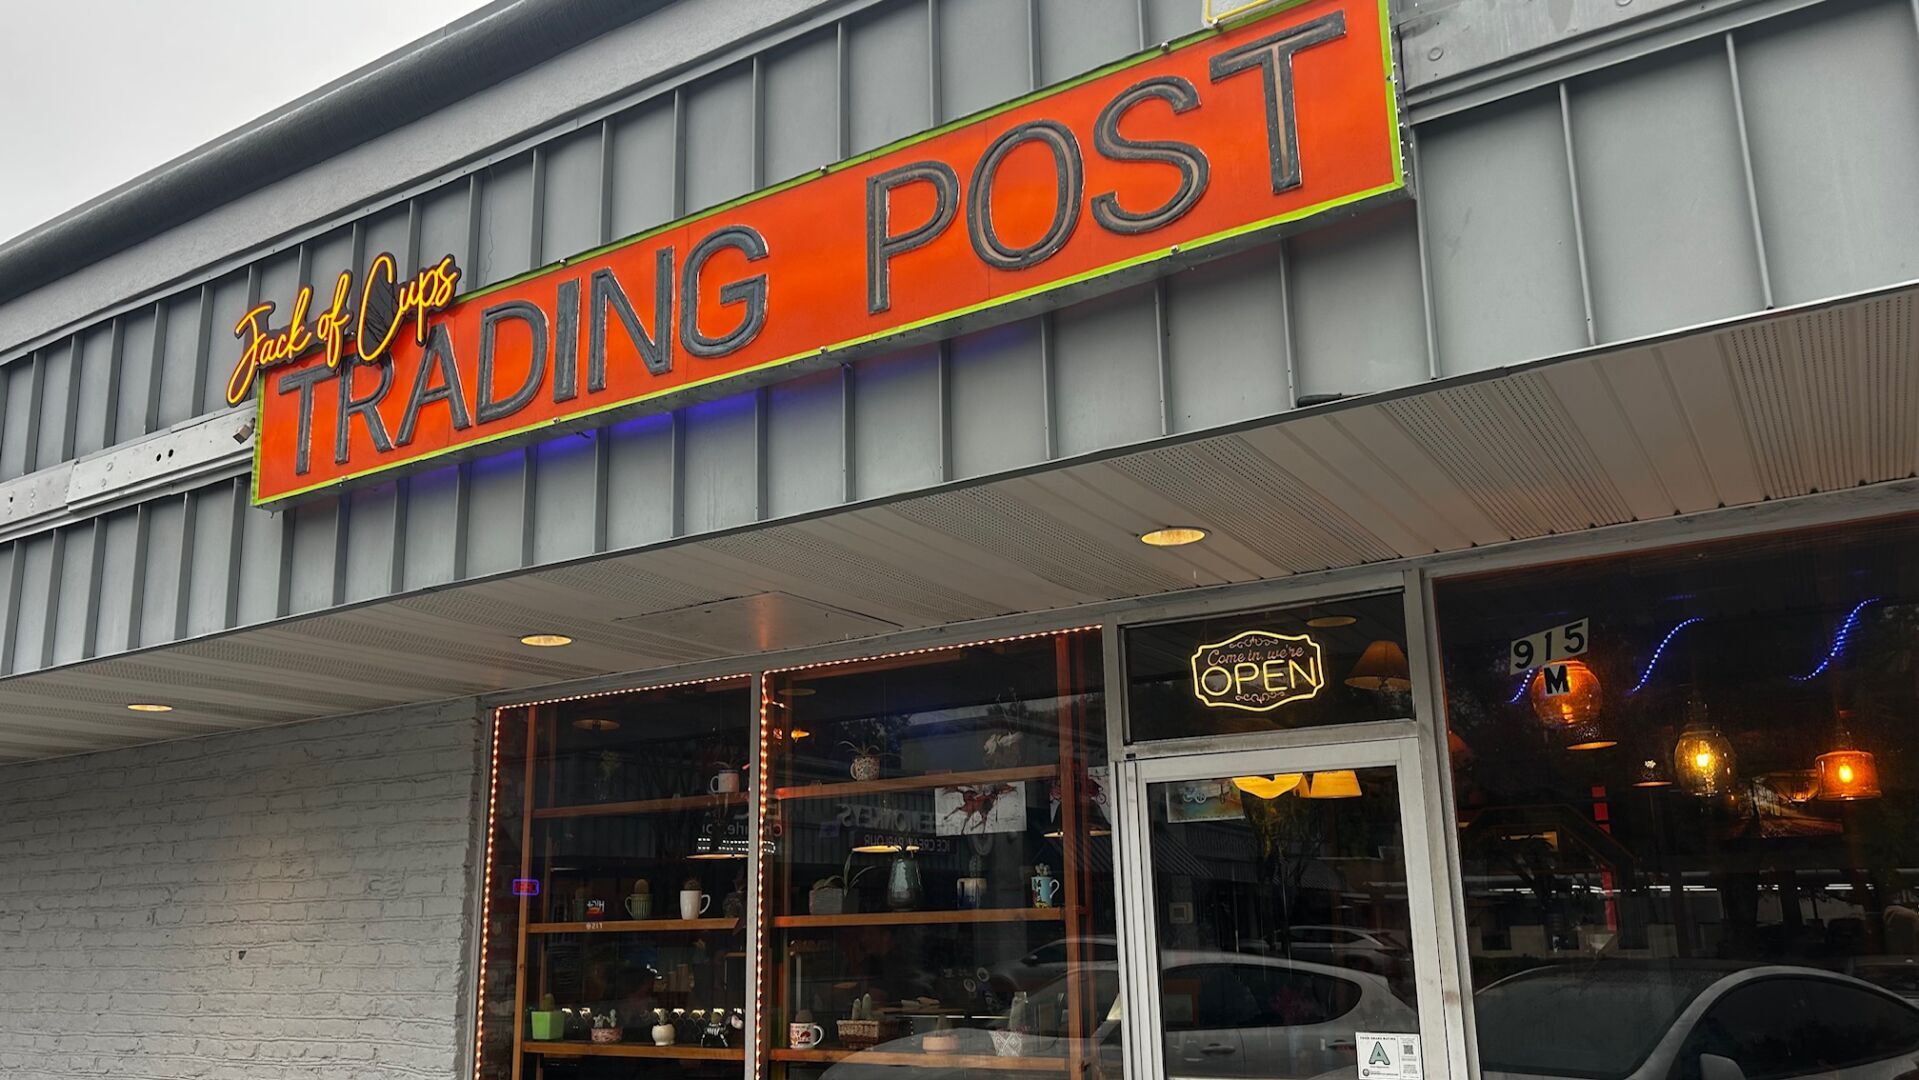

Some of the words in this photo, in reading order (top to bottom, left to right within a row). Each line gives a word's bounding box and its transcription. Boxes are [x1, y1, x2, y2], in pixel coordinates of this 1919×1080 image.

[278, 224, 769, 476] TRADING
[866, 10, 1346, 315] POST
[226, 286, 312, 404] Jack
[318, 272, 350, 368] of
[357, 255, 459, 361] Cups
[1207, 648, 1246, 666] Come
[1267, 644, 1305, 660] we're
[1513, 621, 1585, 669] 915
[1201, 656, 1317, 697] OPEN
[1543, 664, 1570, 695] M
[1368, 1040, 1391, 1066] A
